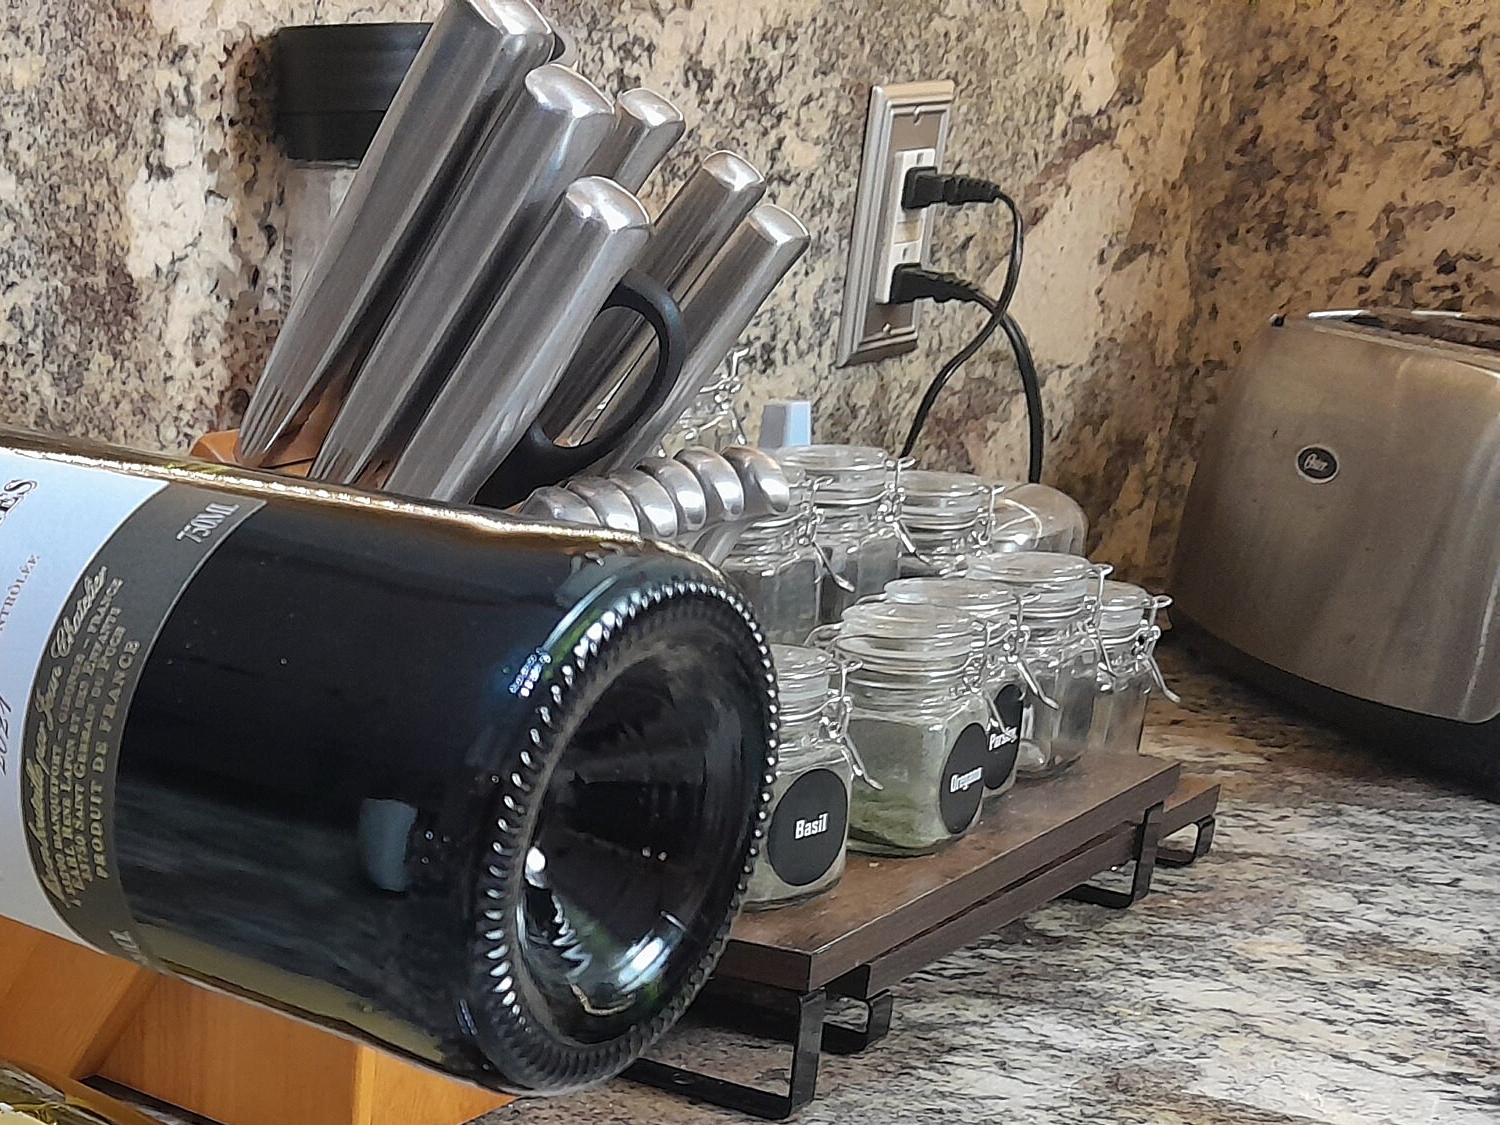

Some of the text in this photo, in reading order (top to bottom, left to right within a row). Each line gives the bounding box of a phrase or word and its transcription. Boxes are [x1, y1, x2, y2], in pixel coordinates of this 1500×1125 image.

[89, 640, 141, 879] PRODUIT DE FRANCE
[794, 812, 829, 840] Basil
